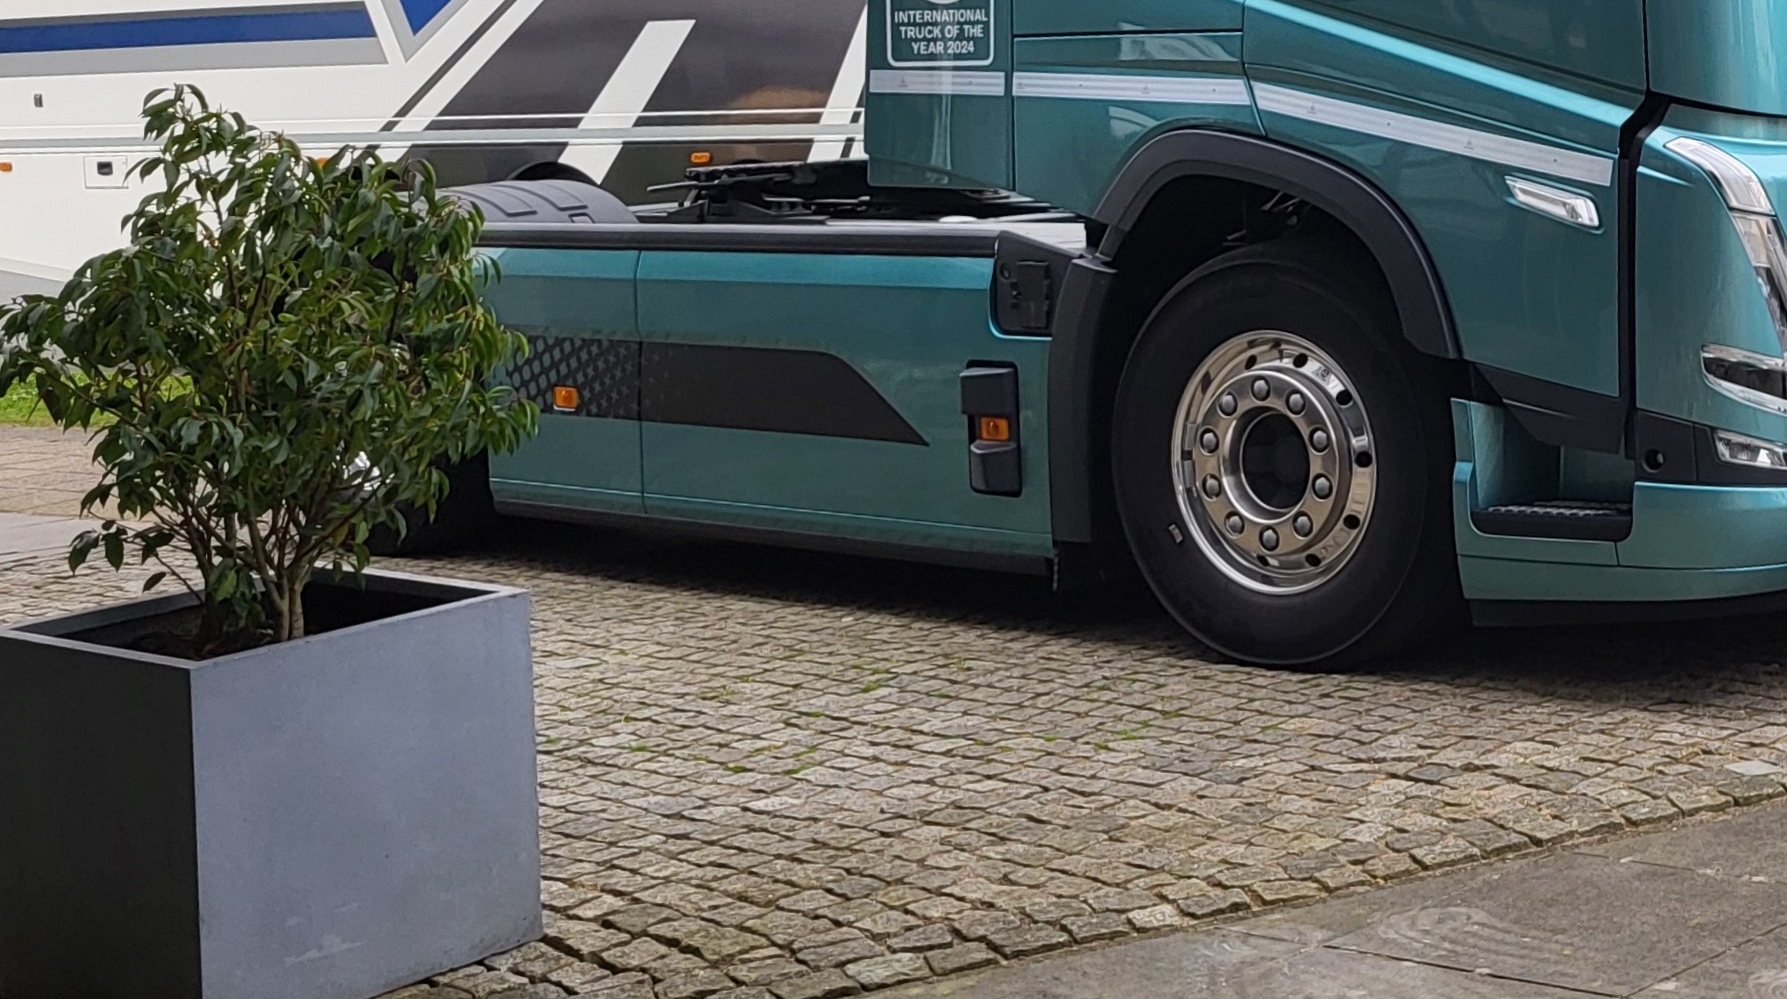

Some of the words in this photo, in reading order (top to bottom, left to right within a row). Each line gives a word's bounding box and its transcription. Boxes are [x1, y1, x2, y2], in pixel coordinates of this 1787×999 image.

[894, 8, 988, 23] INTERNATIONAL
[899, 25, 942, 39] TRUCK
[944, 25, 960, 38] OF
[963, 24, 984, 37] THE
[911, 41, 945, 55] YEAR
[947, 40, 975, 53] 2024
